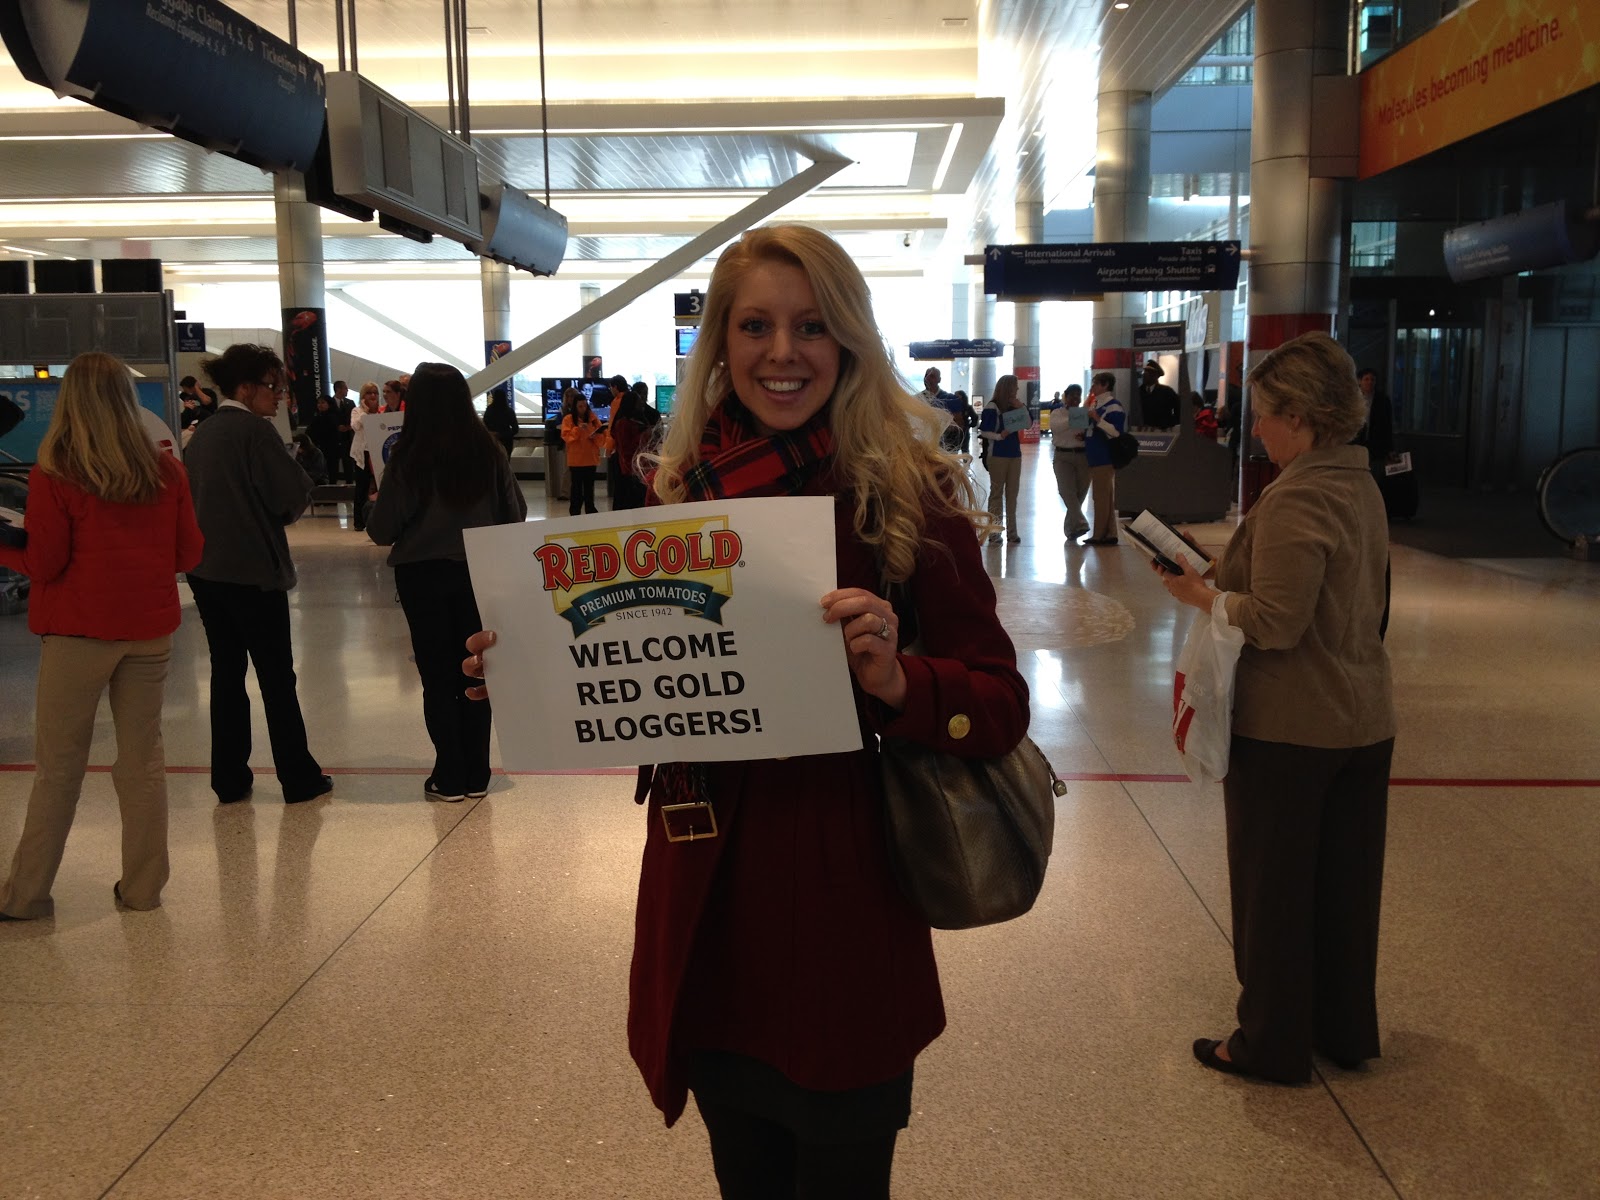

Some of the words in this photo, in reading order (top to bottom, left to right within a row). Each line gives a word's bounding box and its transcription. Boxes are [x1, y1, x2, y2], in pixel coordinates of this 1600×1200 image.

[197, 4, 224, 36] Claim
[226, 22, 235, 44] 4,
[237, 28, 246, 49] 5,
[247, 34, 254, 52] 6
[261, 41, 297, 82] Ticketing
[1378, 88, 1427, 125] Molecules
[1430, 54, 1488, 102] becoming
[1493, 18, 1563, 71] medicine.
[1025, 249, 1080, 258] International
[1083, 248, 1116, 257] Arrivals
[1181, 247, 1202, 255] Taxis
[1097, 267, 1128, 276] Airport
[1130, 267, 1163, 276] Parking
[1166, 266, 1201, 274] Shuttles
[690, 296, 701, 313] 3
[1136, 336, 1179, 344] TRANSPORTATION
[534, 543, 620, 591] RED
[624, 530, 742, 578] GOLD
[579, 588, 636, 617] PREMIUM
[639, 586, 707, 605] TOMATOES
[616, 610, 648, 621] SINCE
[651, 607, 673, 617] 1942
[569, 631, 737, 668] WELCOME
[577, 679, 641, 706] RED
[654, 670, 745, 699] GOLD
[575, 708, 763, 743] BLOGGERS!
